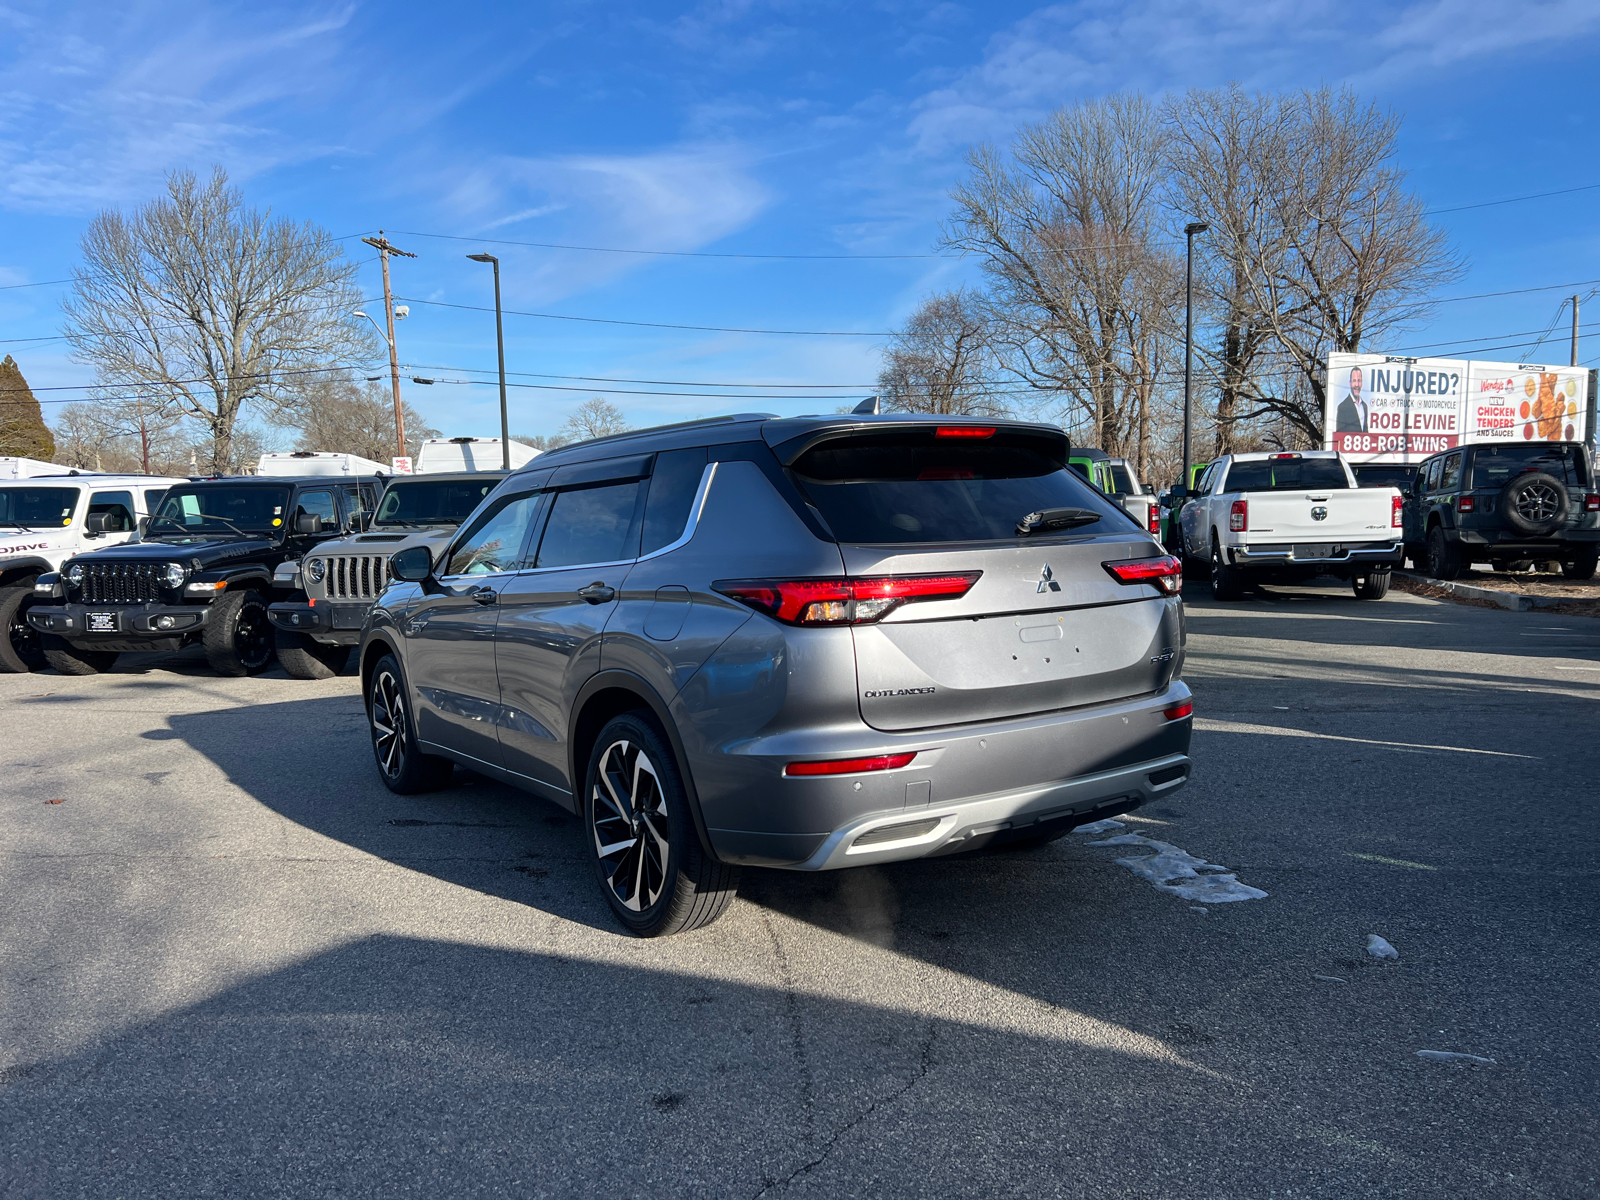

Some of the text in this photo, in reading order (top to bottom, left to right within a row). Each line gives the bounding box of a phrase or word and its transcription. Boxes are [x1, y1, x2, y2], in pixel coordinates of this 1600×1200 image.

[1371, 369, 1459, 395] INJURED?
[1480, 378, 1505, 393] Wendy's
[1376, 399, 1457, 409] CAR TRUCK MOTORCYCLE
[1490, 397, 1504, 405] NEW
[1477, 406, 1516, 417] CHICKEN
[1370, 413, 1456, 430] ROB LEVINE
[1477, 418, 1515, 428] TENDERS
[1343, 435, 1448, 451] 888-ROB-WINS
[864, 686, 936, 698] OUTLANDER
